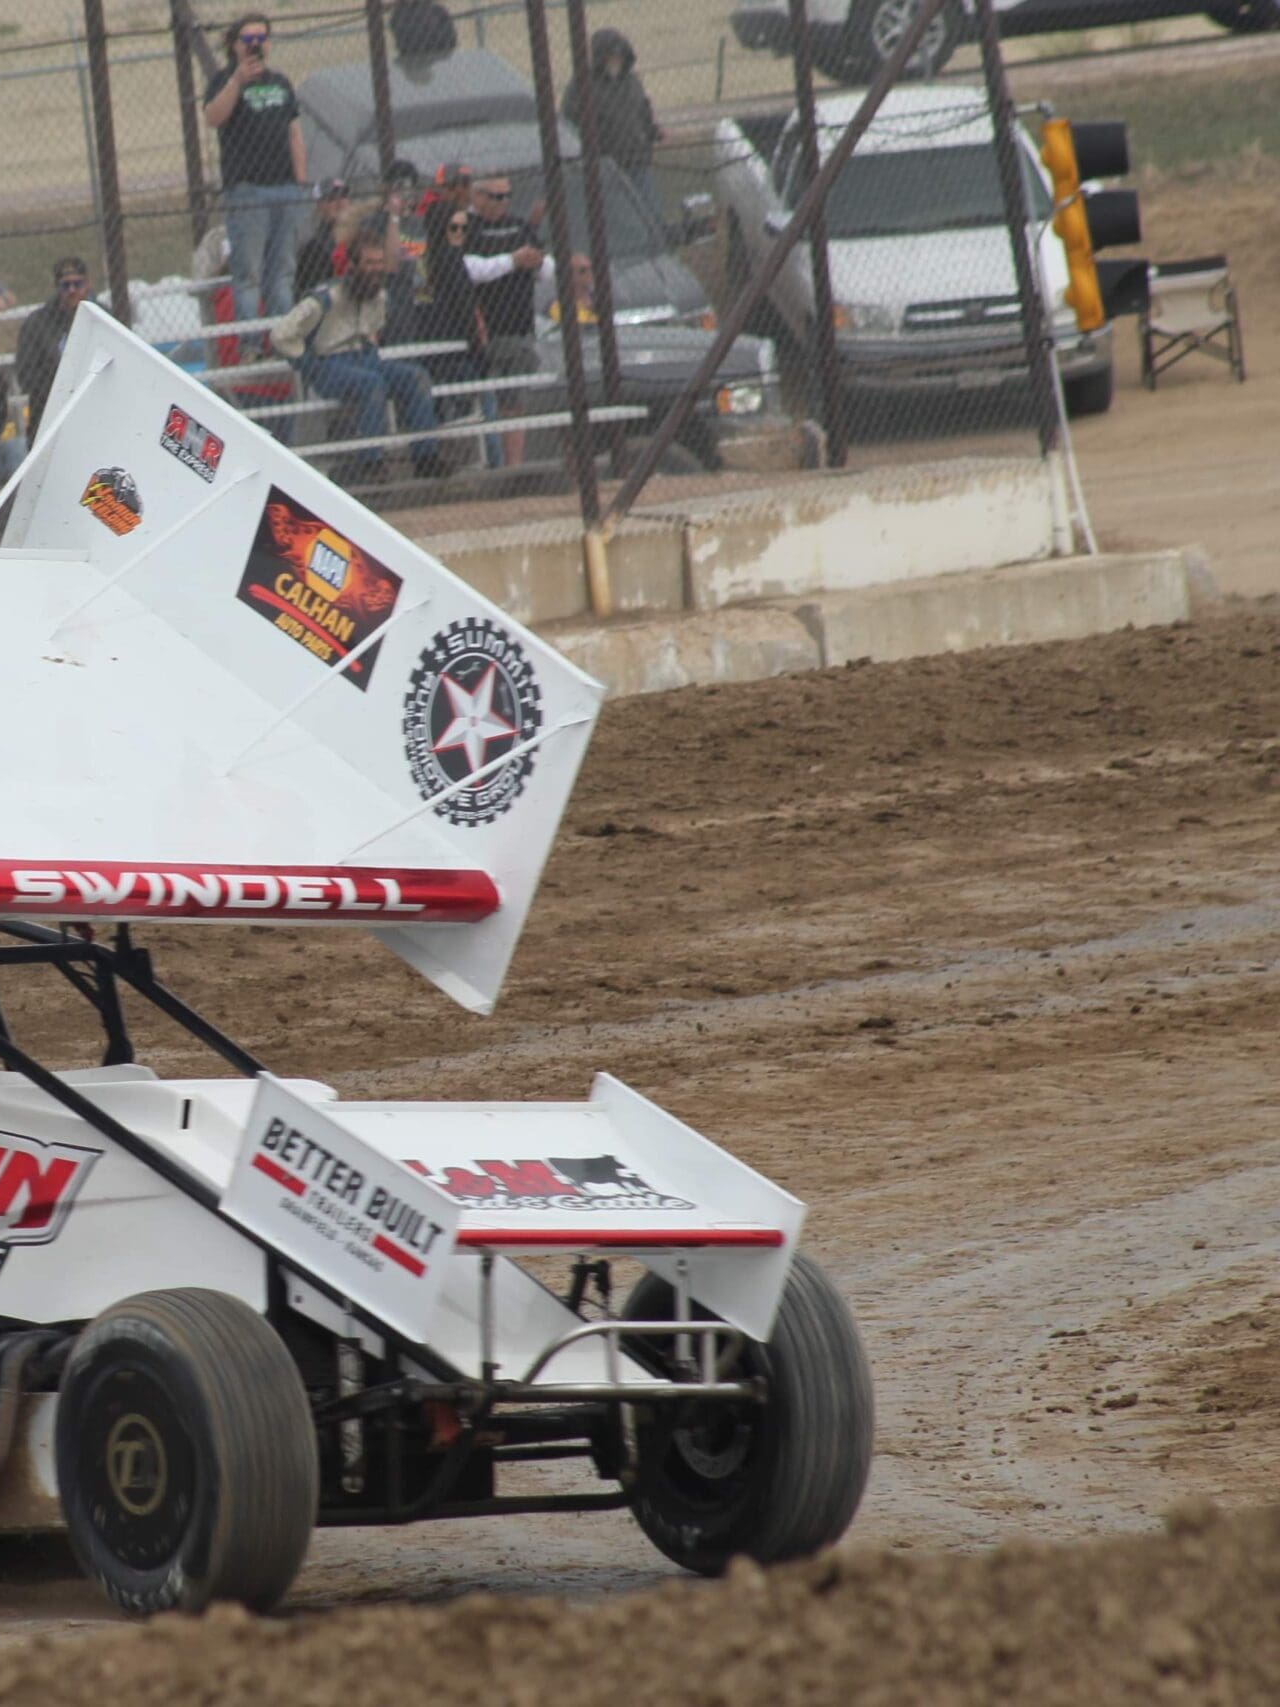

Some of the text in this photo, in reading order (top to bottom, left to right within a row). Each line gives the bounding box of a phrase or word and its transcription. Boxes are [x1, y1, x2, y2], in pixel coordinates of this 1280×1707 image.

[309, 541, 350, 591] NAPA
[273, 573, 356, 643] CALHAN
[274, 612, 302, 640] AUTO
[446, 630, 536, 708] SUMMIT
[10, 869, 426, 913] SWINDELL
[261, 1115, 445, 1255] BETTER BUILT
[547, 1193, 694, 1211] Cattle
[306, 1189, 373, 1244] TRAILERS
